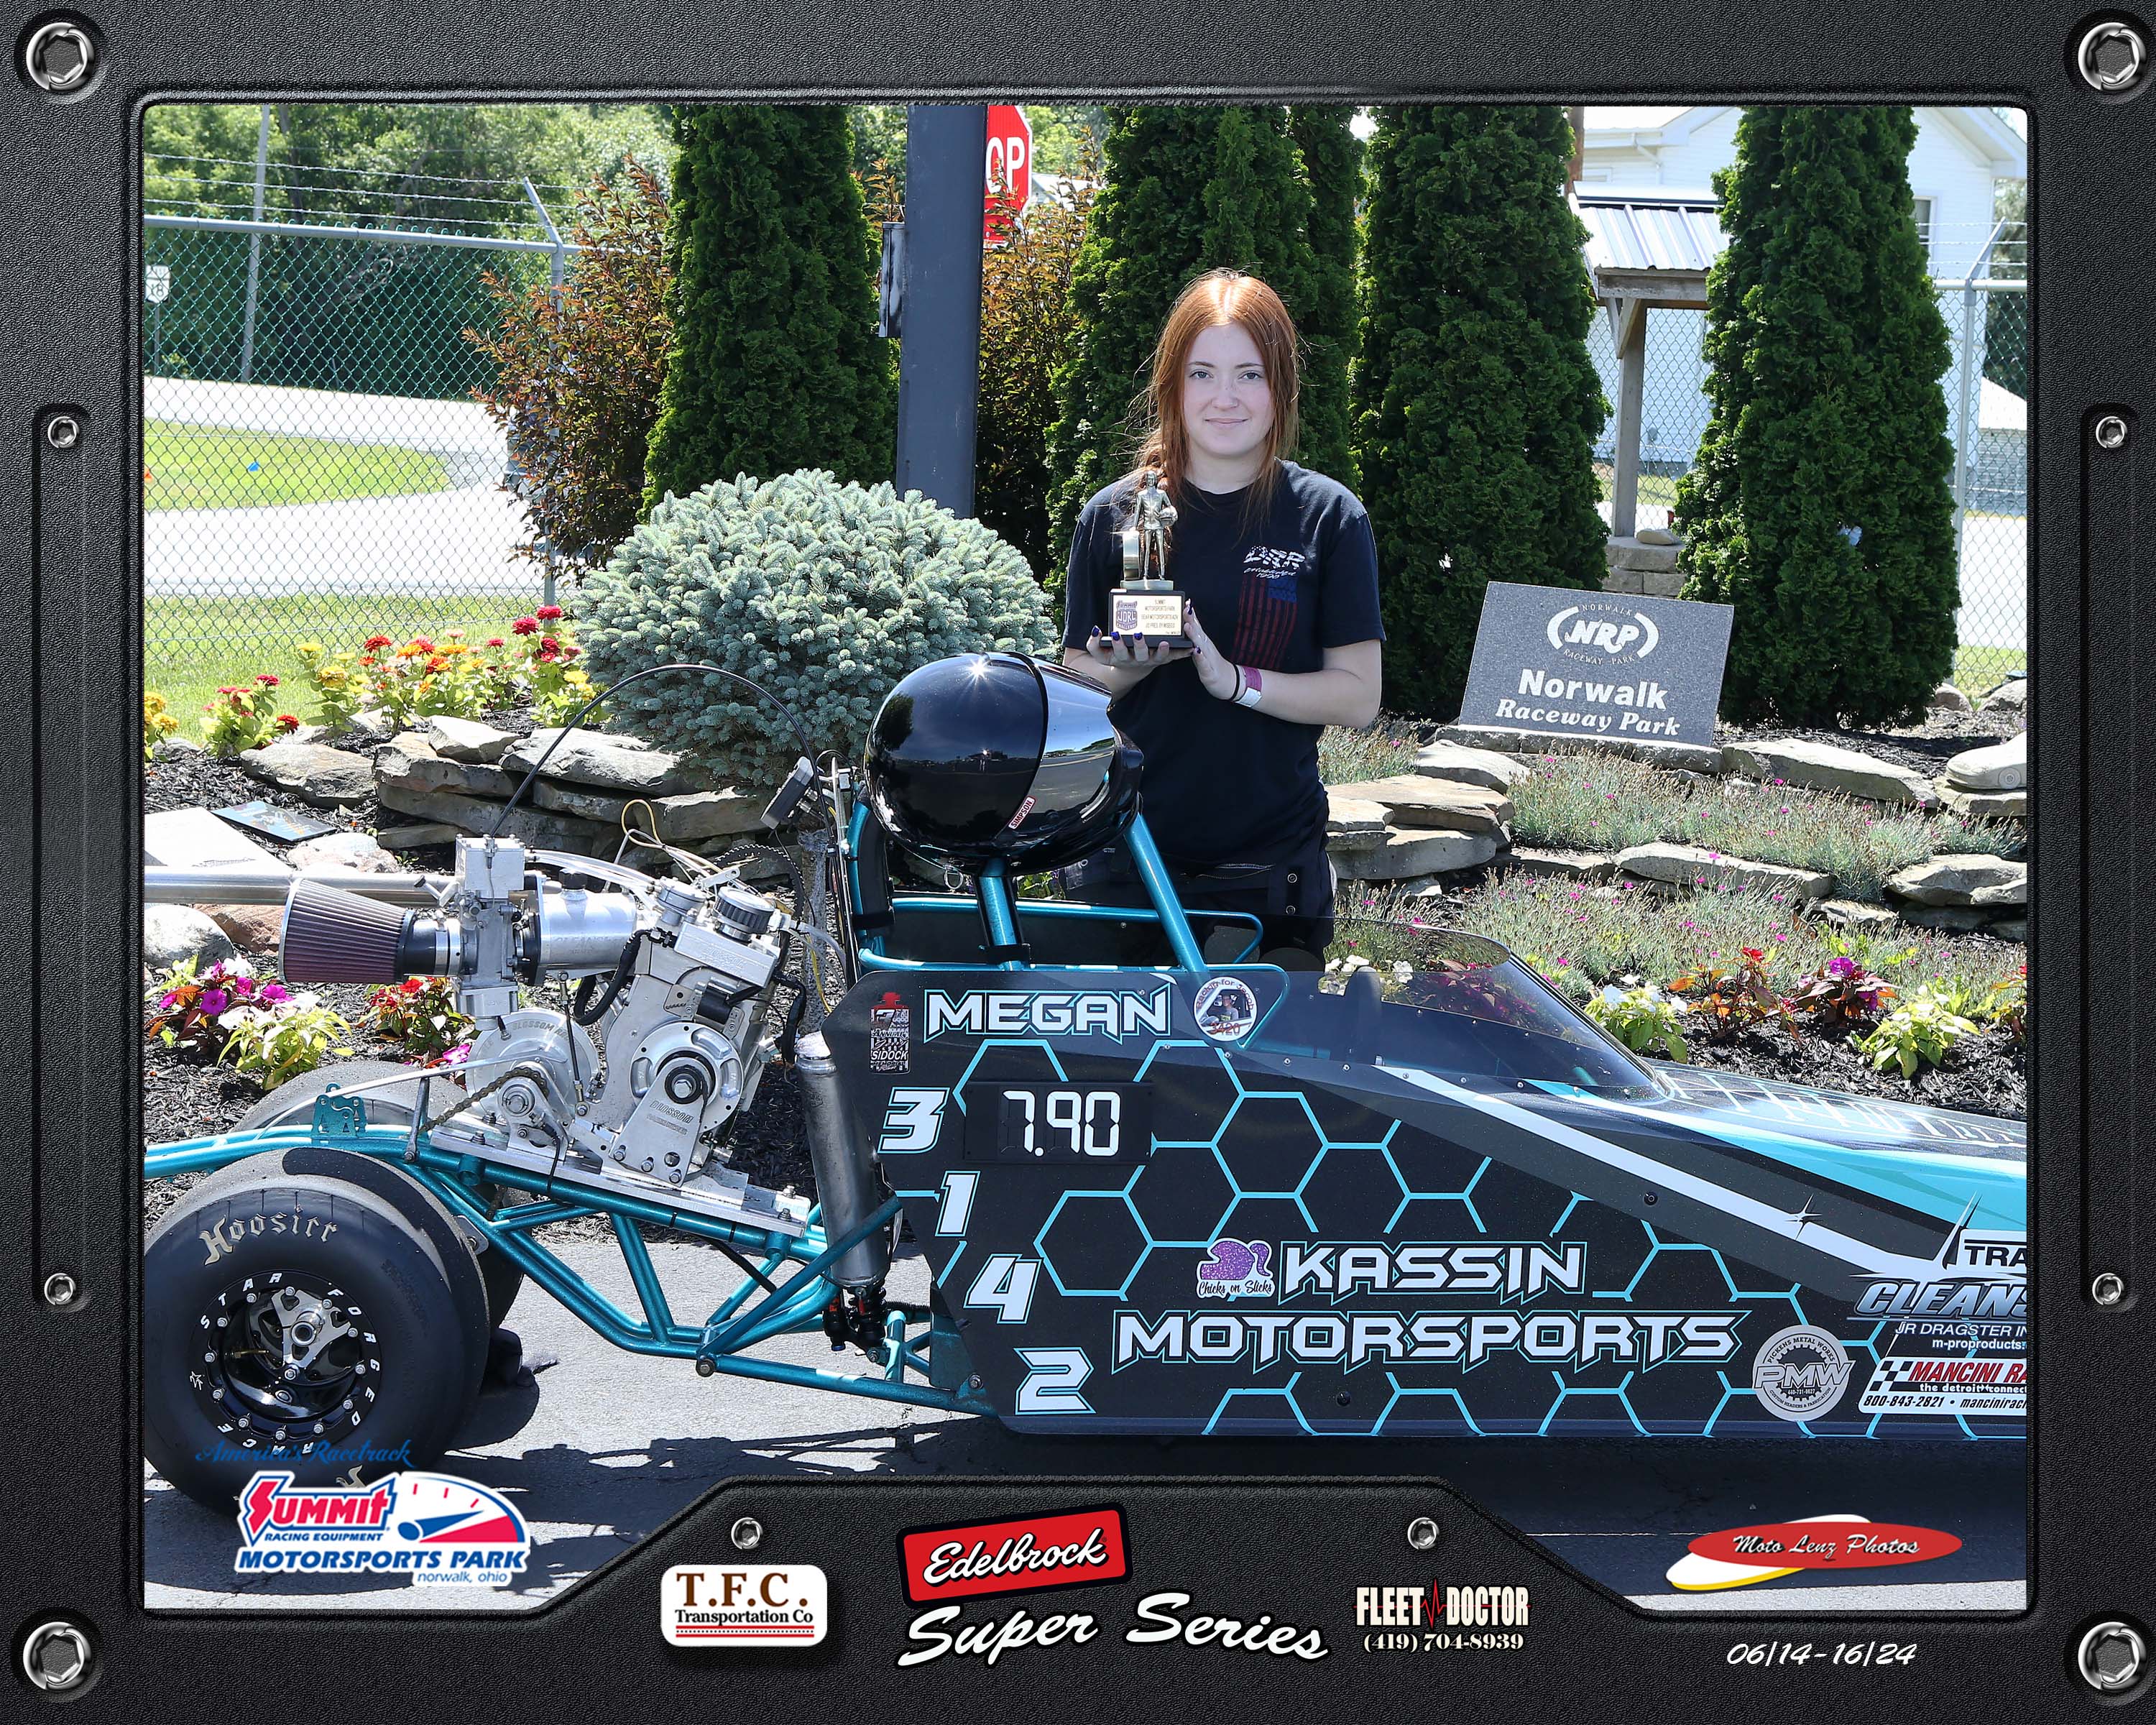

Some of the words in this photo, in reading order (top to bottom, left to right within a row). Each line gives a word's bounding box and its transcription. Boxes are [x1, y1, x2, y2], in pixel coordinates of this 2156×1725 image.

[986, 137, 1026, 194] OP
[1118, 610, 1136, 622] JDRL
[1583, 604, 1634, 616] NORWALK
[1564, 619, 1640, 654] NRP
[1563, 648, 1603, 665] RACEWAY
[1611, 654, 1635, 665] PARK
[1518, 668, 1669, 710] Norwalk
[1495, 699, 1613, 733] Raceway
[1618, 712, 1681, 736] Park
[1010, 799, 1033, 827] SIMPSON
[1197, 980, 1220, 1009] Racing
[1236, 984, 1255, 1011] Jacob
[923, 983, 1171, 1044] MEGAN
[871, 1050, 908, 1060] SIDOCK
[1003, 1090, 1122, 1157] 7.90
[198, 1204, 338, 1266] Hoosier
[1964, 1245, 2027, 1266] TRA
[1279, 1241, 1588, 1305] KASSIN
[1198, 1281, 1226, 1296] Chicks
[1230, 1284, 1241, 1293] on
[1244, 1279, 1272, 1294] Slicks
[1111, 1310, 1751, 1374] MOTORSPORTS
[1895, 1321, 1915, 1335] JR
[1920, 1323, 2012, 1337] DRAGSTER
[200, 1272, 282, 1329] STAR
[327, 1289, 381, 1427] FORGED
[1767, 1339, 1792, 1363] PICKENS
[1792, 1336, 1816, 1345] METAL
[1816, 1341, 1835, 1362] WORKS
[1932, 1338, 2027, 1351] m-proproducts.
[1753, 1361, 1856, 1389] PMW
[1908, 1361, 2004, 1383] MANCINI
[1769, 1389, 1784, 1404] CUSTOM
[1807, 1387, 1832, 1407] FABRICATION
[1920, 1383, 1938, 1392] the
[1942, 1383, 1981, 1393] detroit
[1863, 1395, 1946, 1409] 800-843-2821
[1960, 1397, 2027, 1409] manciniraci
